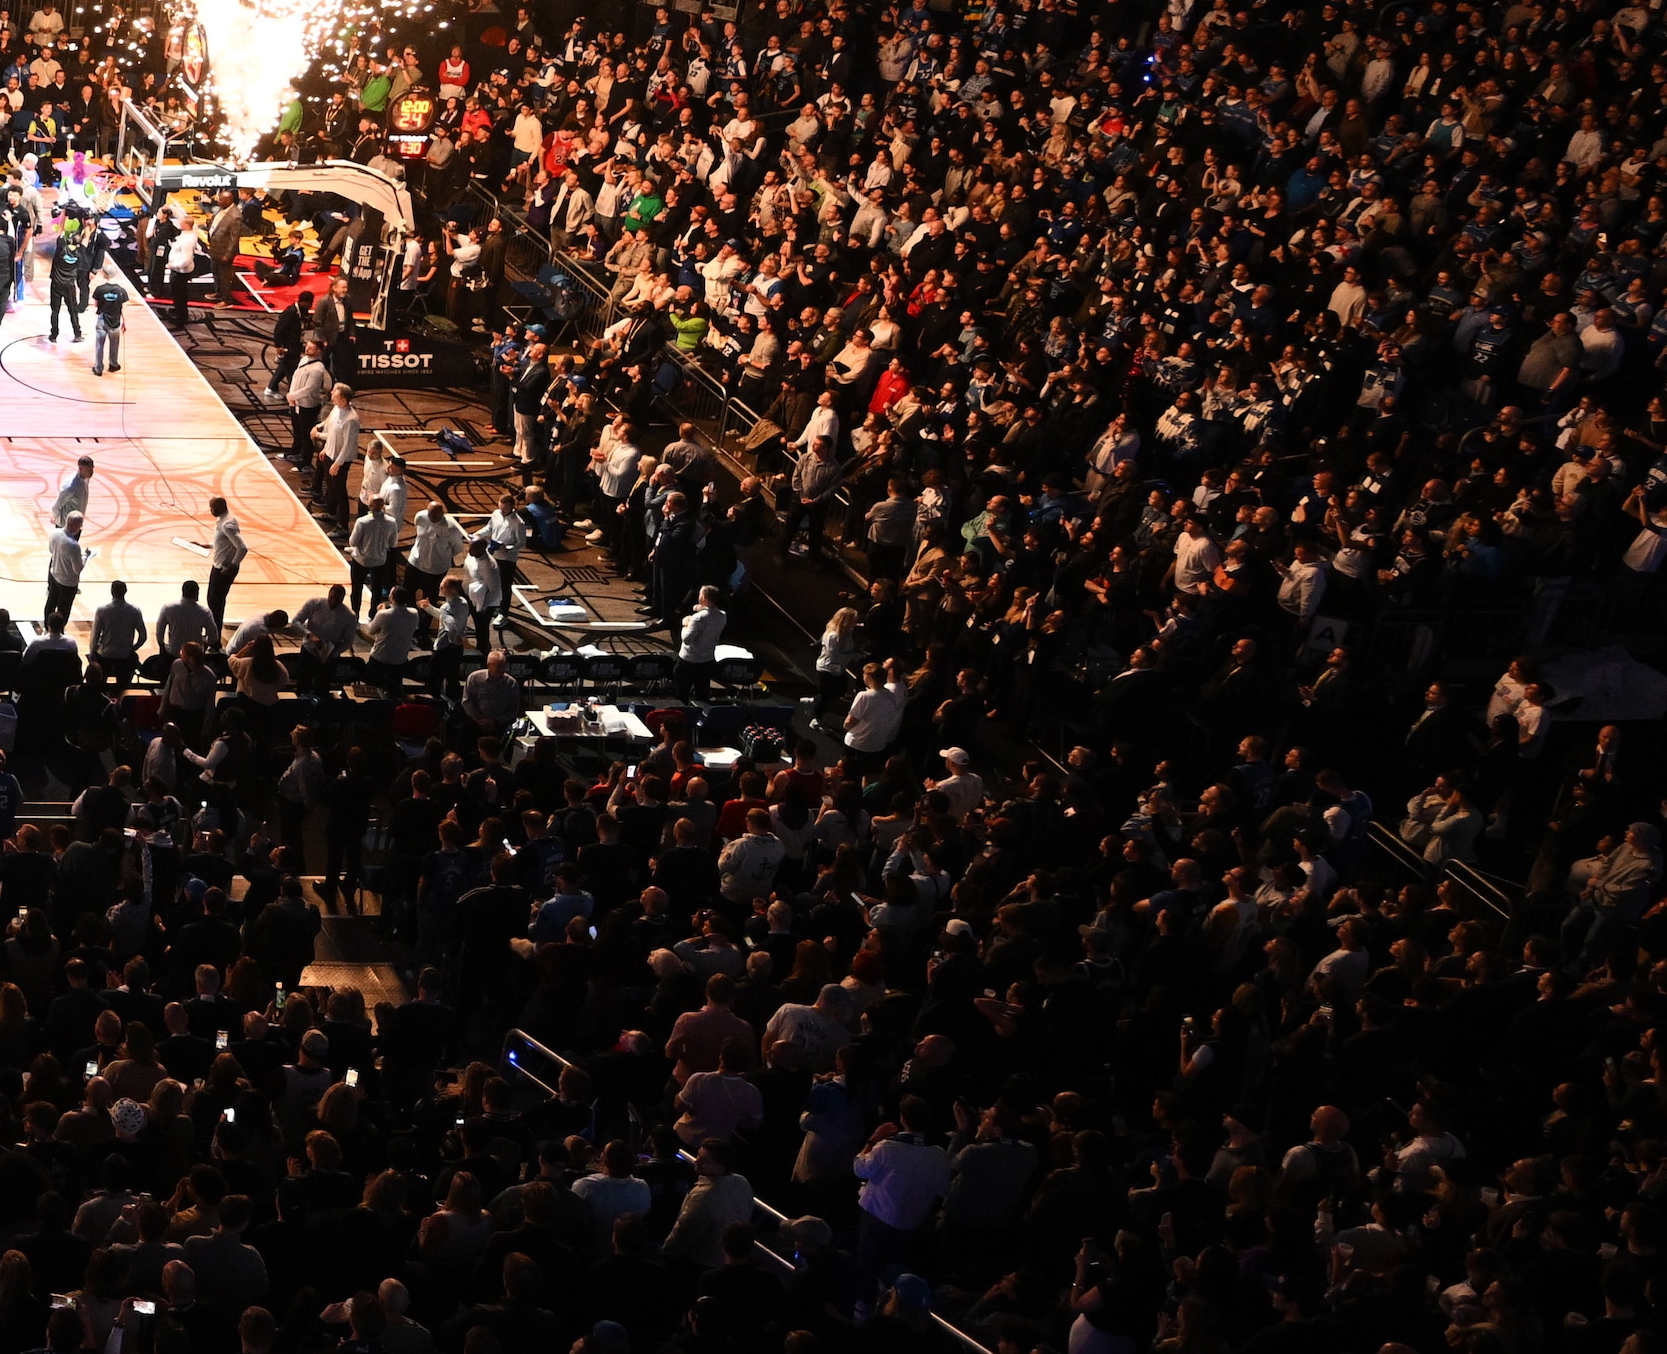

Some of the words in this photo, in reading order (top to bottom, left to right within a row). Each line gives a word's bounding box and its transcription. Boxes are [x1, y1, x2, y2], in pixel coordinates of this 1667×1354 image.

[400, 100, 430, 114] 12:00
[398, 112, 423, 127] 24
[399, 142, 423, 155] 1:30
[181, 174, 233, 189] Revolut
[359, 244, 374, 256] GET
[358, 256, 372, 267] THE
[357, 353, 434, 369] TISSOT
[1314, 625, 1336, 644] A
